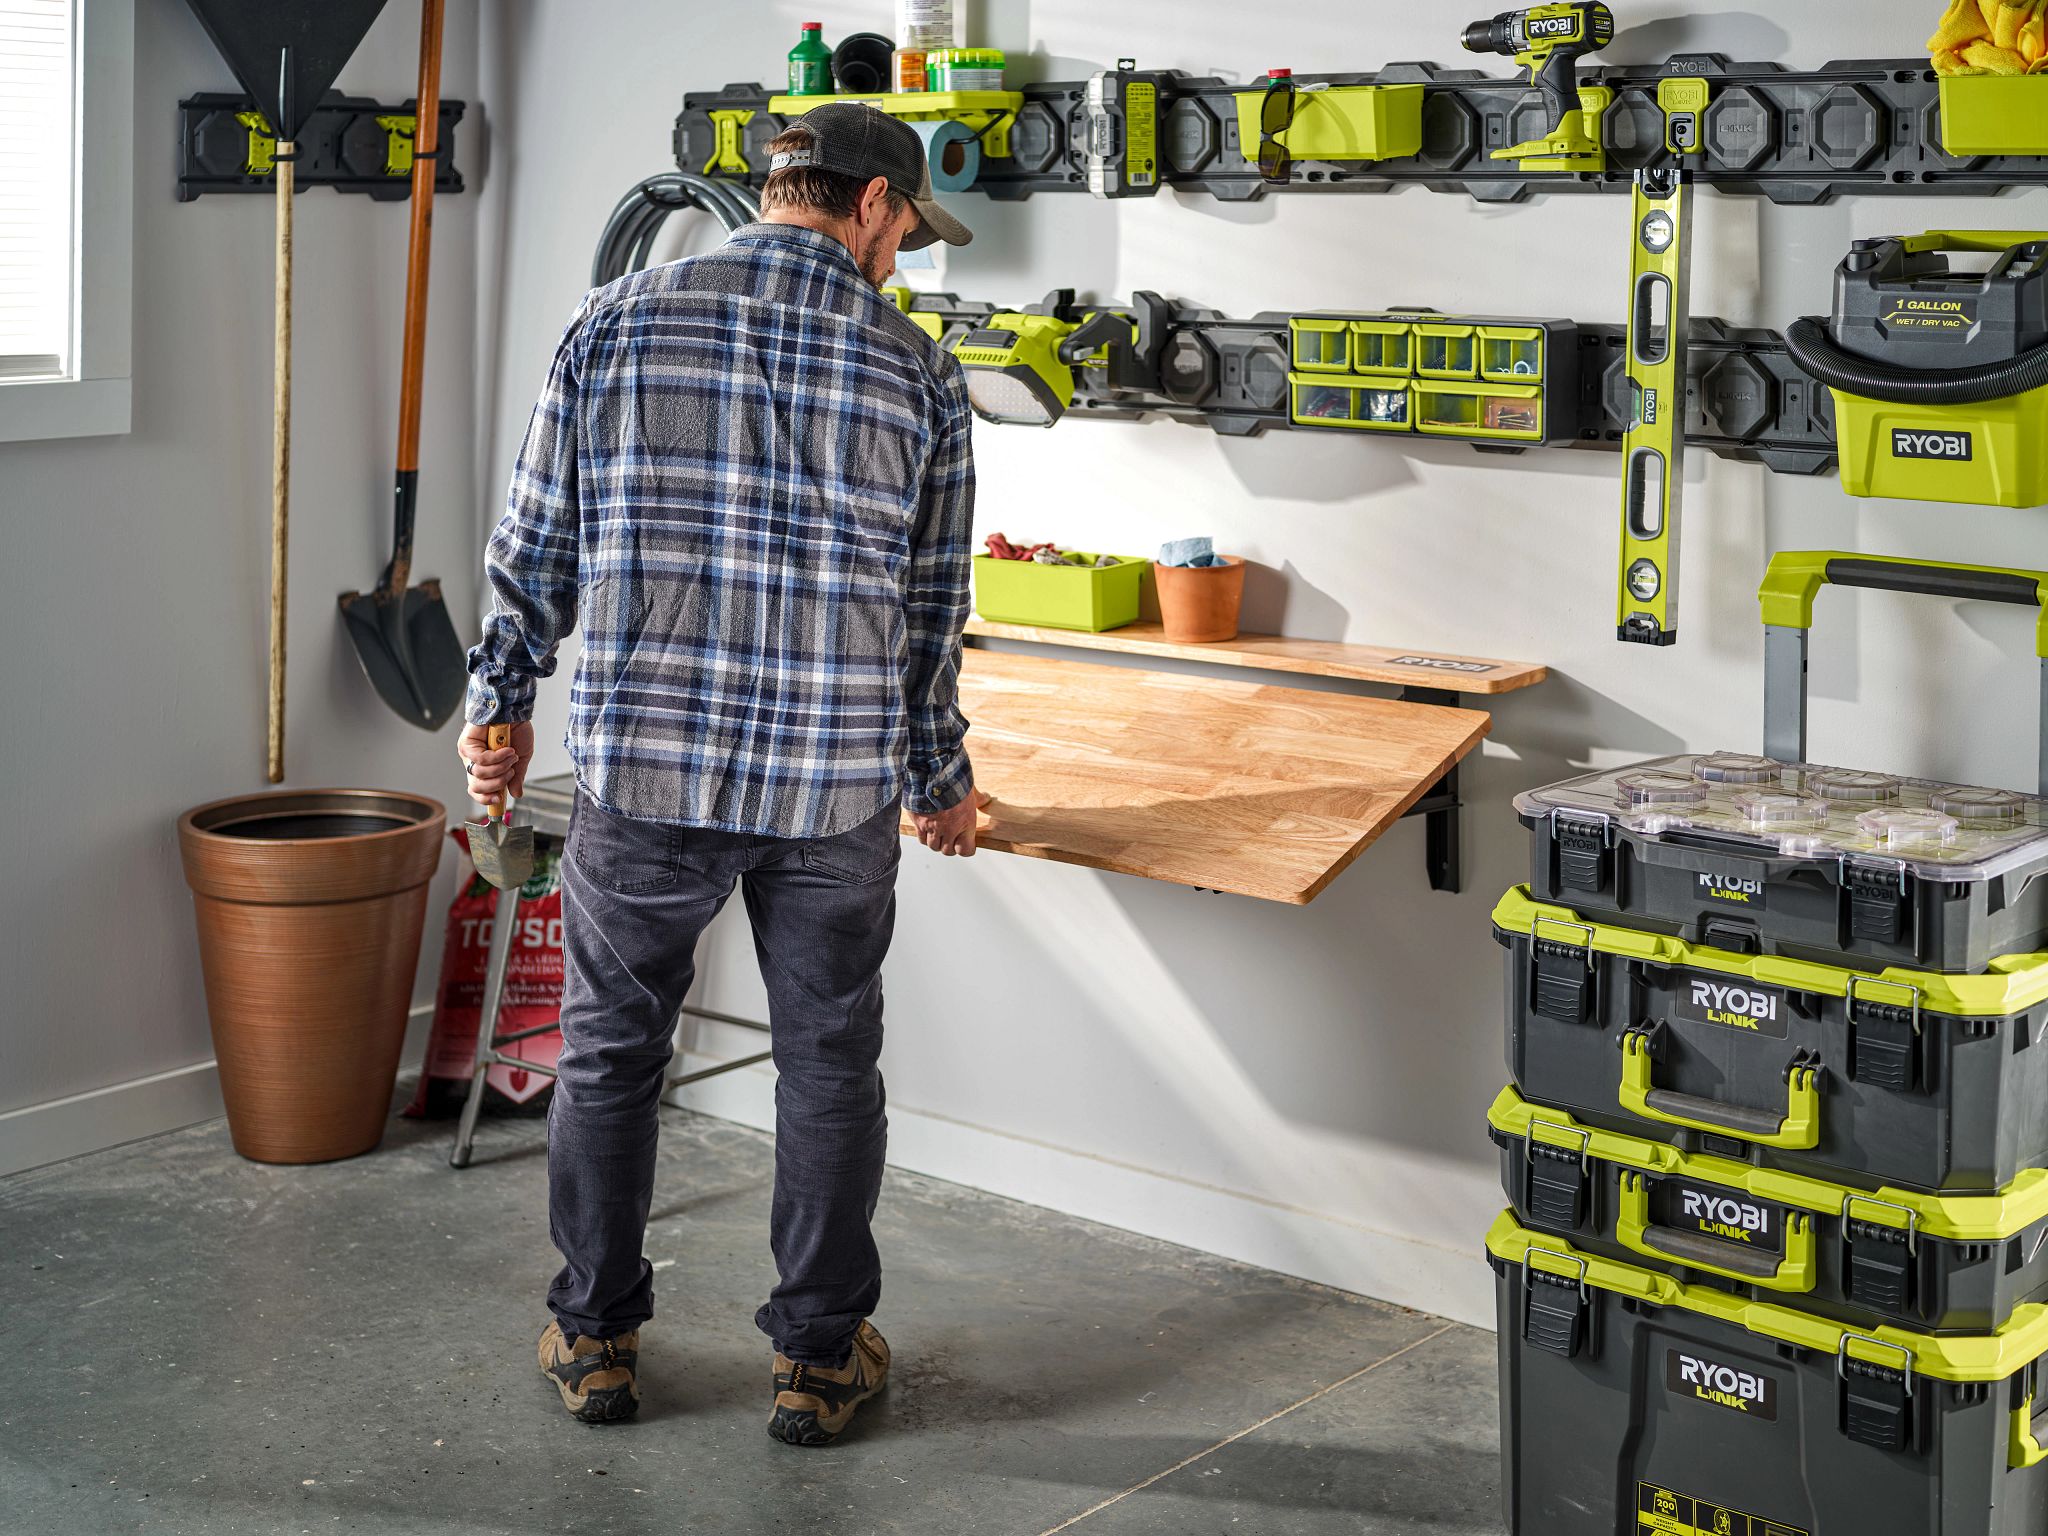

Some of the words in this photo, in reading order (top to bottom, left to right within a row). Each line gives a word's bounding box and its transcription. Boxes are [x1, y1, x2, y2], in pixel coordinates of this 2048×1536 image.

[1530, 17, 1571, 34] RYOBI
[1670, 62, 1710, 73] RYOBI
[1665, 89, 1698, 101] RYOBI
[1896, 299, 1904, 310] 1
[1907, 301, 1962, 312] GALLON
[1896, 318, 1914, 326] WET
[1922, 319, 1941, 327] DRY
[1942, 320, 1960, 328] VAC
[1645, 390, 1655, 422] RYOBI
[1895, 433, 1967, 456] RYOBI
[1395, 656, 1491, 672] RYOBI
[1563, 837, 1596, 851] RYOBI
[1699, 873, 1762, 895] RYOBI
[1855, 884, 1893, 900] RYOBI
[1710, 888, 1750, 902] LINK
[1691, 980, 1777, 1020] RYOBI
[1707, 1009, 1759, 1030] LINK
[1682, 1189, 1768, 1233] RYOBI
[1700, 1219, 1751, 1242] LINK
[1680, 1354, 1764, 1403] RYOBI
[1696, 1385, 1748, 1411] LINK
[1656, 1498, 1675, 1511] 200
